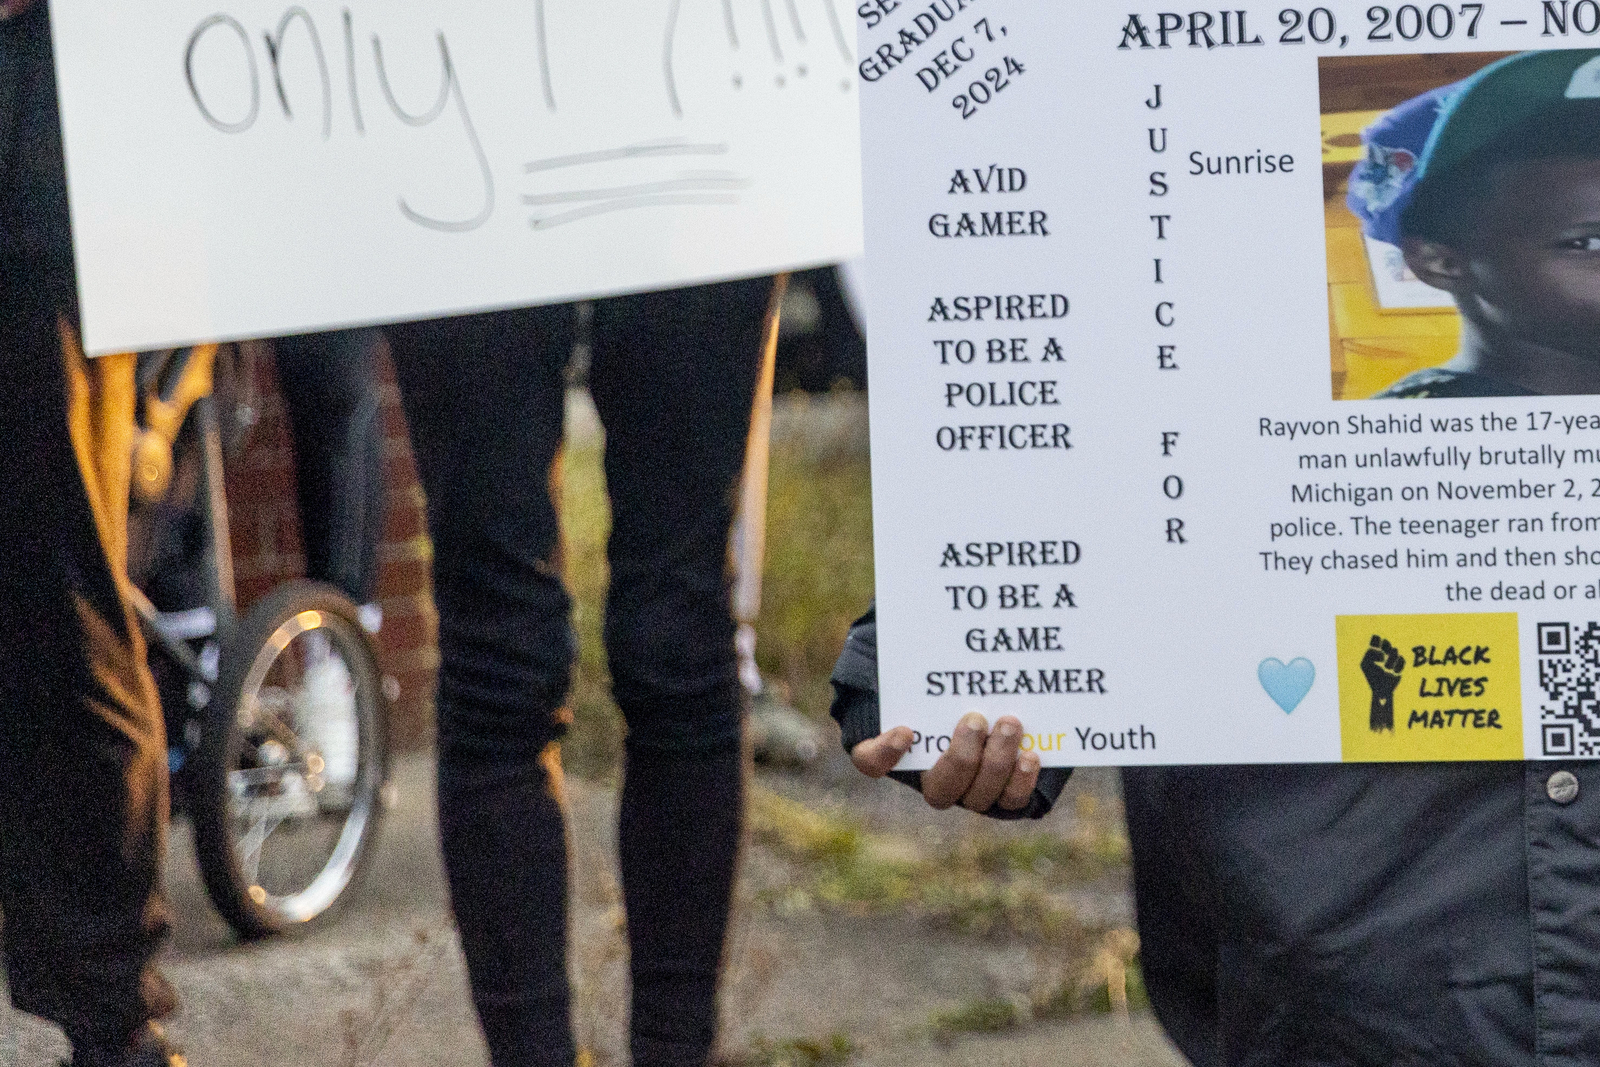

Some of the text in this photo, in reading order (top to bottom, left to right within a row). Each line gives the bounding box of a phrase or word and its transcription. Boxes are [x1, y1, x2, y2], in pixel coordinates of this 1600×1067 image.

[1118, 10, 1262, 49] APRIL
[1278, 7, 1347, 47] 20,
[1366, 3, 1483, 41] 2007
[915, 17, 1007, 93] DEC 7,
[952, 56, 1027, 120] 2024
[185, 6, 495, 232] only
[1189, 150, 1294, 176] Sunrise
[948, 164, 1027, 194] AVID
[928, 210, 1049, 238] GAMER
[928, 293, 1069, 322] ASPIRED
[933, 337, 1064, 365] TO BE A
[945, 380, 1059, 408] POLICE
[936, 423, 1072, 451] OFFICER
[1259, 417, 1340, 440] Rayvon
[1347, 413, 1422, 435] Shahid
[1430, 417, 1474, 433] was
[1480, 412, 1517, 432] the
[1299, 454, 1347, 469] man
[1355, 446, 1471, 470] unlawfully
[1479, 444, 1565, 468] brutally
[1291, 483, 1393, 507] Michigan
[1401, 486, 1429, 501] on
[1437, 479, 1555, 500] November
[1564, 478, 1583, 501] 2,
[1270, 517, 1343, 541] police.
[1350, 515, 1391, 535] The
[1399, 518, 1499, 538] teenager
[1508, 518, 1544, 533] ran
[940, 540, 1081, 568] ASPIRED
[1259, 551, 1313, 574] They
[1321, 549, 1398, 570] chased
[1407, 549, 1448, 568] him
[1456, 547, 1497, 568] and
[1505, 547, 1556, 567] then
[945, 583, 1076, 610] TO BE A
[1445, 581, 1482, 602] the
[1490, 580, 1545, 601] dead
[1553, 585, 1577, 600] or
[965, 626, 1063, 652] GAME
[1411, 645, 1491, 668] BLACK
[926, 668, 1106, 697] STREAMER
[1419, 676, 1488, 698] LIVES
[1407, 708, 1502, 729] MATTER
[1075, 724, 1156, 751] Youth
